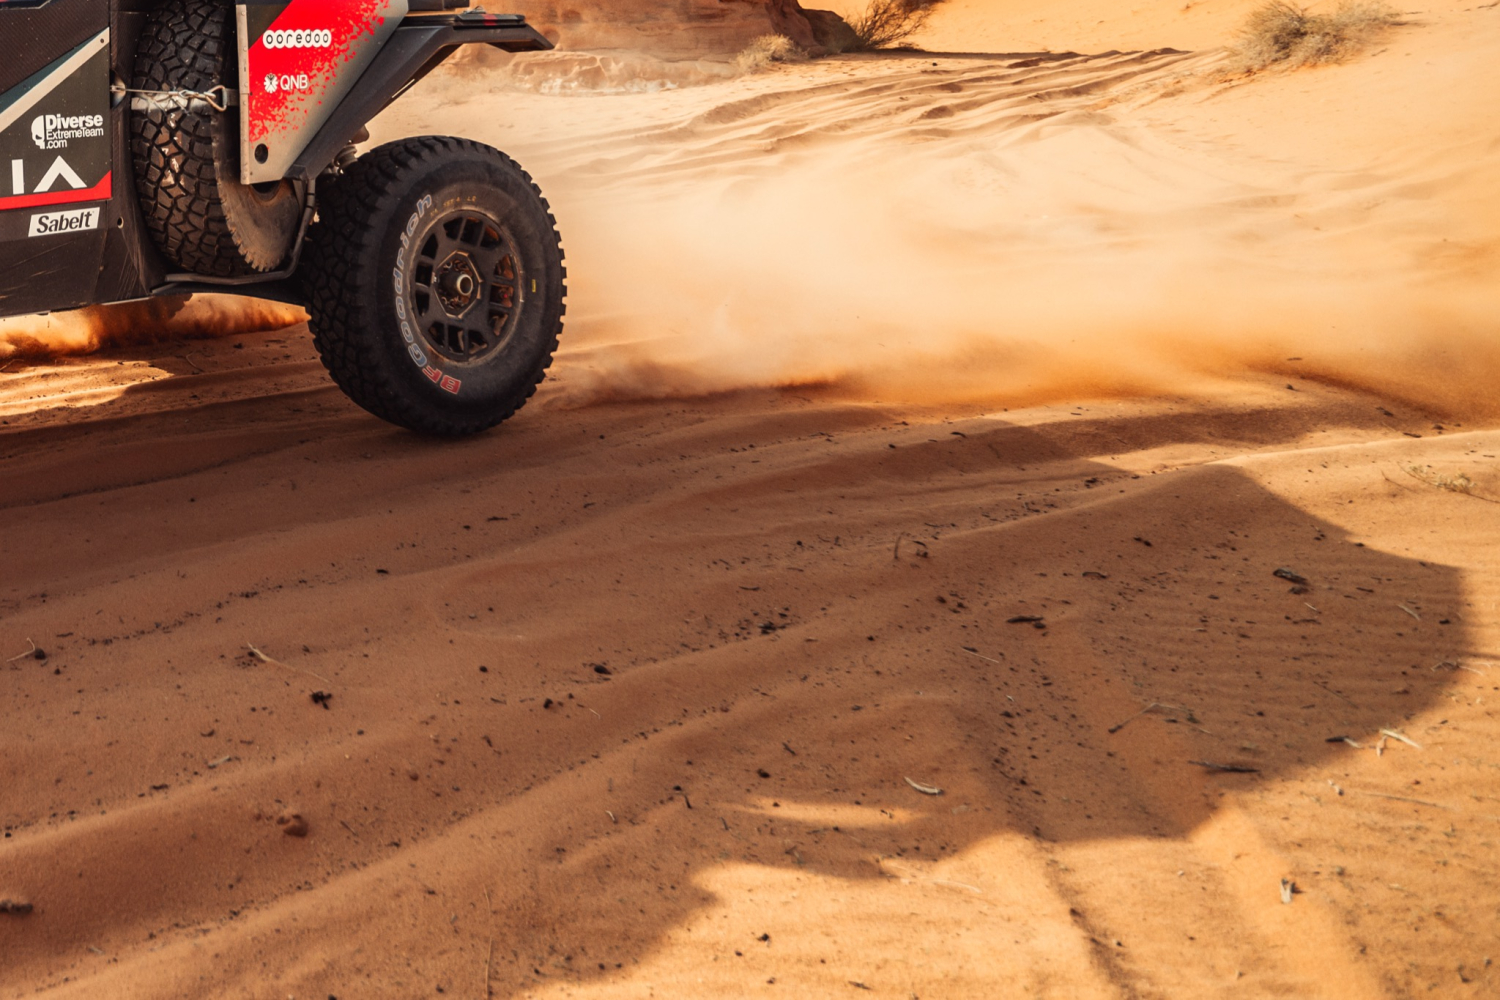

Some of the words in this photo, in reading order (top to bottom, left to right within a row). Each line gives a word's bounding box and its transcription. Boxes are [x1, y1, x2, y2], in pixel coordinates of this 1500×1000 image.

[264, 29, 330, 47] ooredoo
[280, 74, 308, 91] QNB
[45, 113, 104, 130] Diverse
[46, 127, 104, 140] ExtremeTeam
[46, 139, 68, 149] .com
[36, 210, 93, 234] Sabelt
[393, 194, 462, 394] BFGoodrich
